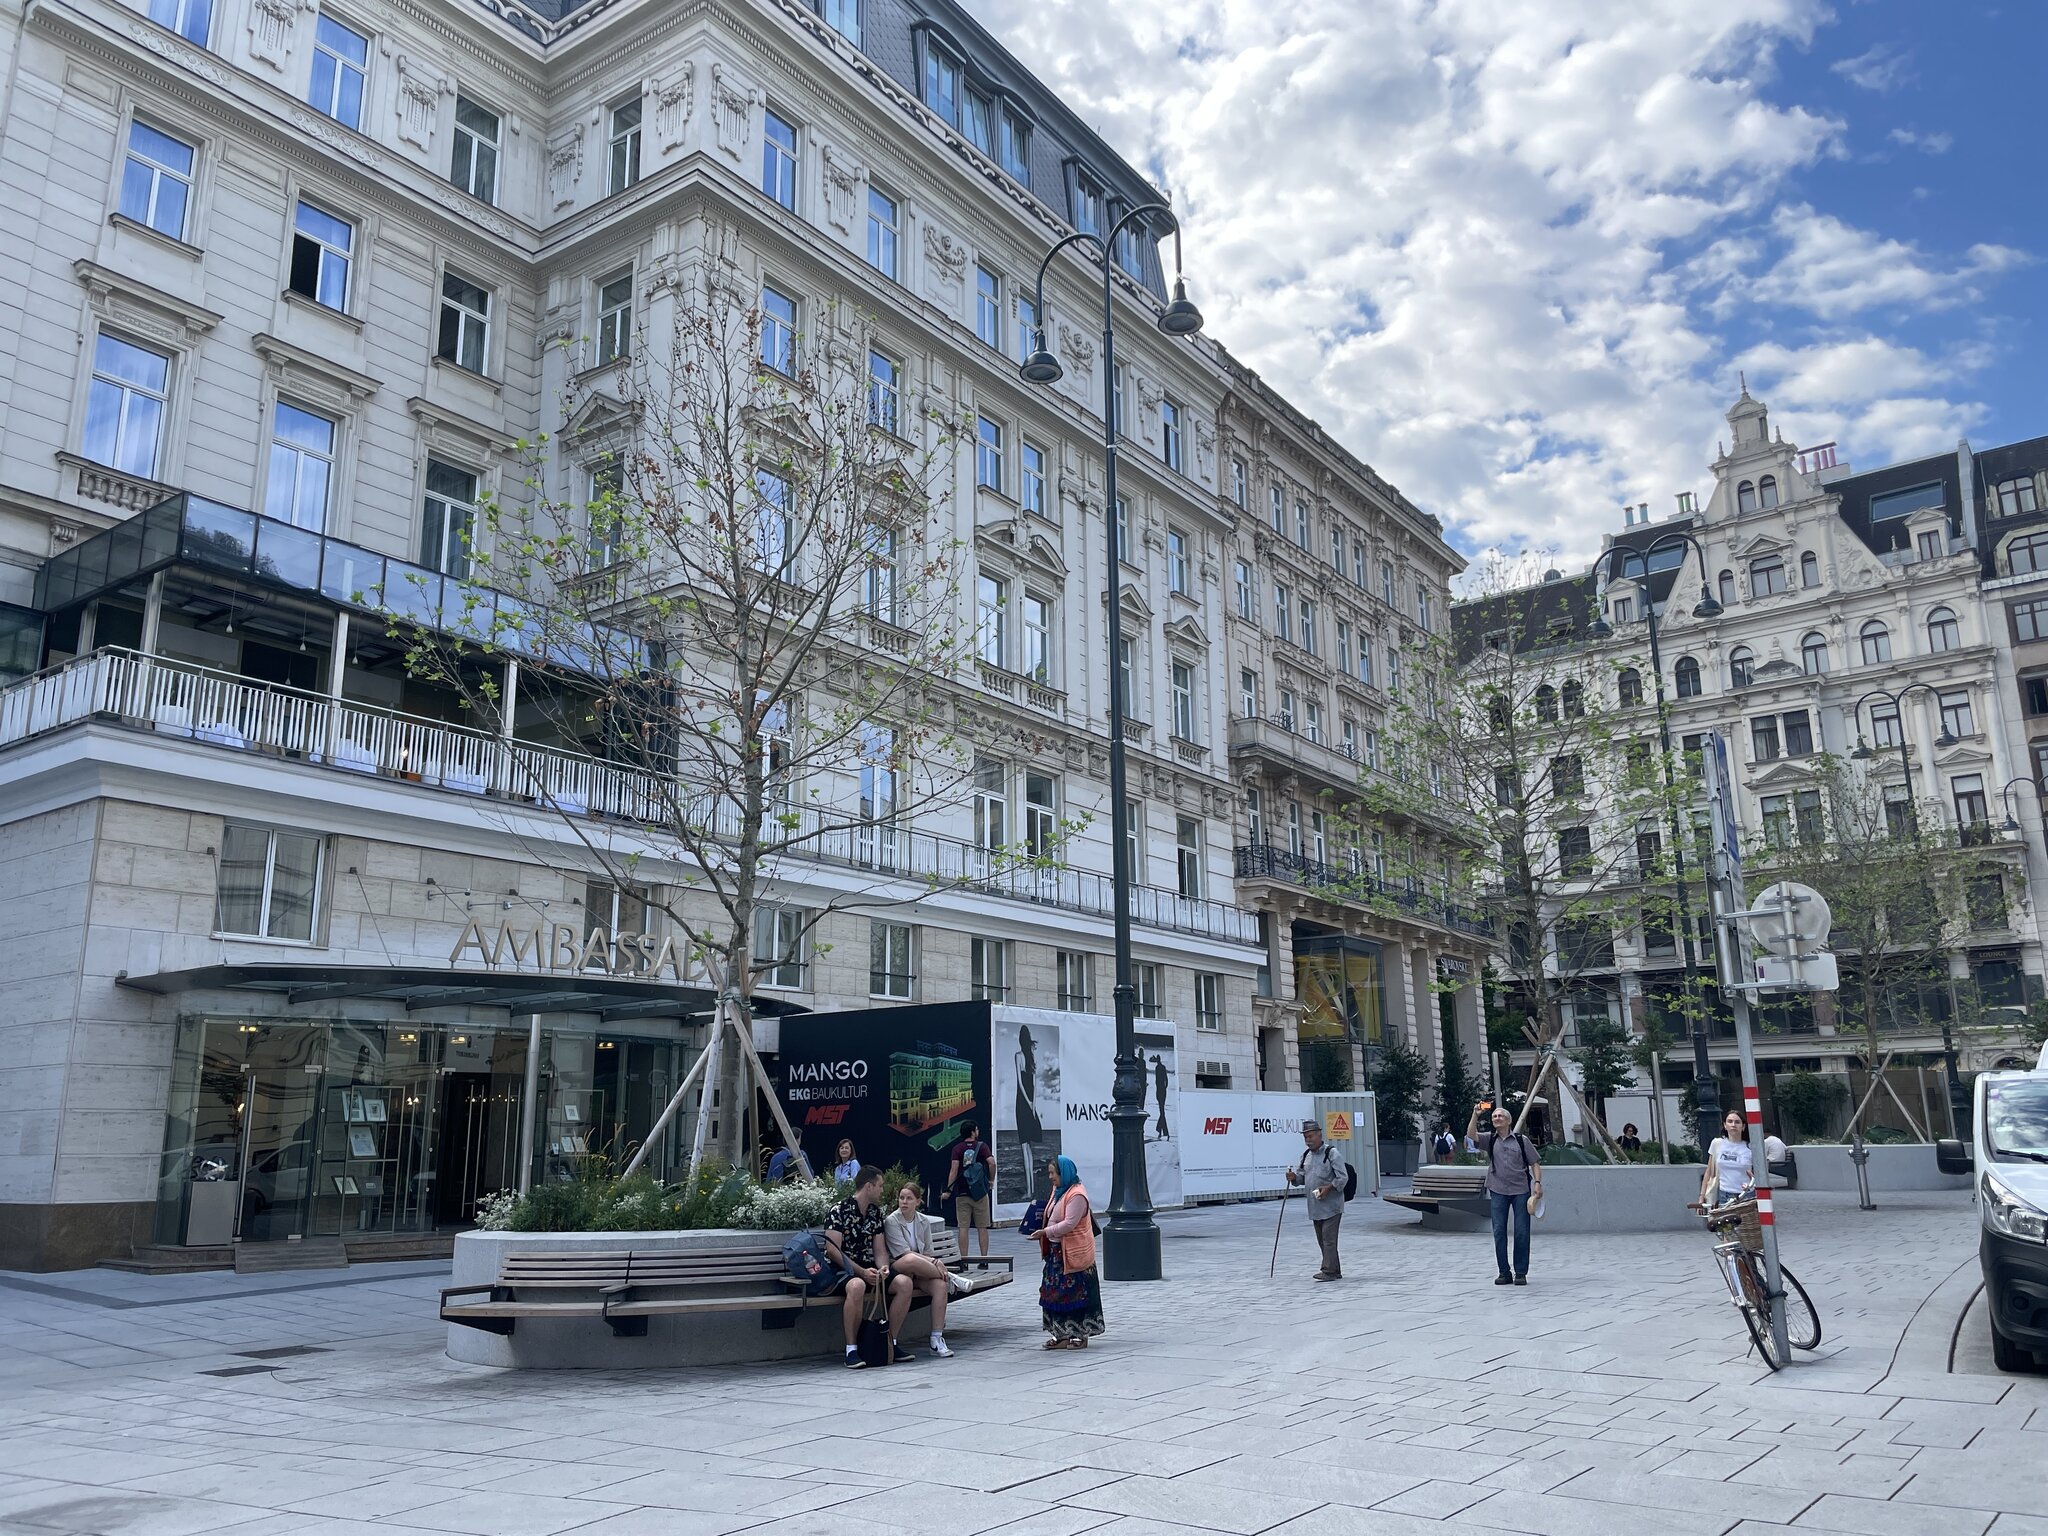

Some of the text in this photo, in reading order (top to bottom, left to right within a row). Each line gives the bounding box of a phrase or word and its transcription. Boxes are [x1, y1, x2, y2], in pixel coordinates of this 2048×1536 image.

[449, 916, 710, 981] AMBASSAD
[789, 1060, 868, 1083] MANGO
[804, 1104, 850, 1126] MST
[1203, 1117, 1233, 1135] MST
[1253, 1118, 1272, 1133] EKG
